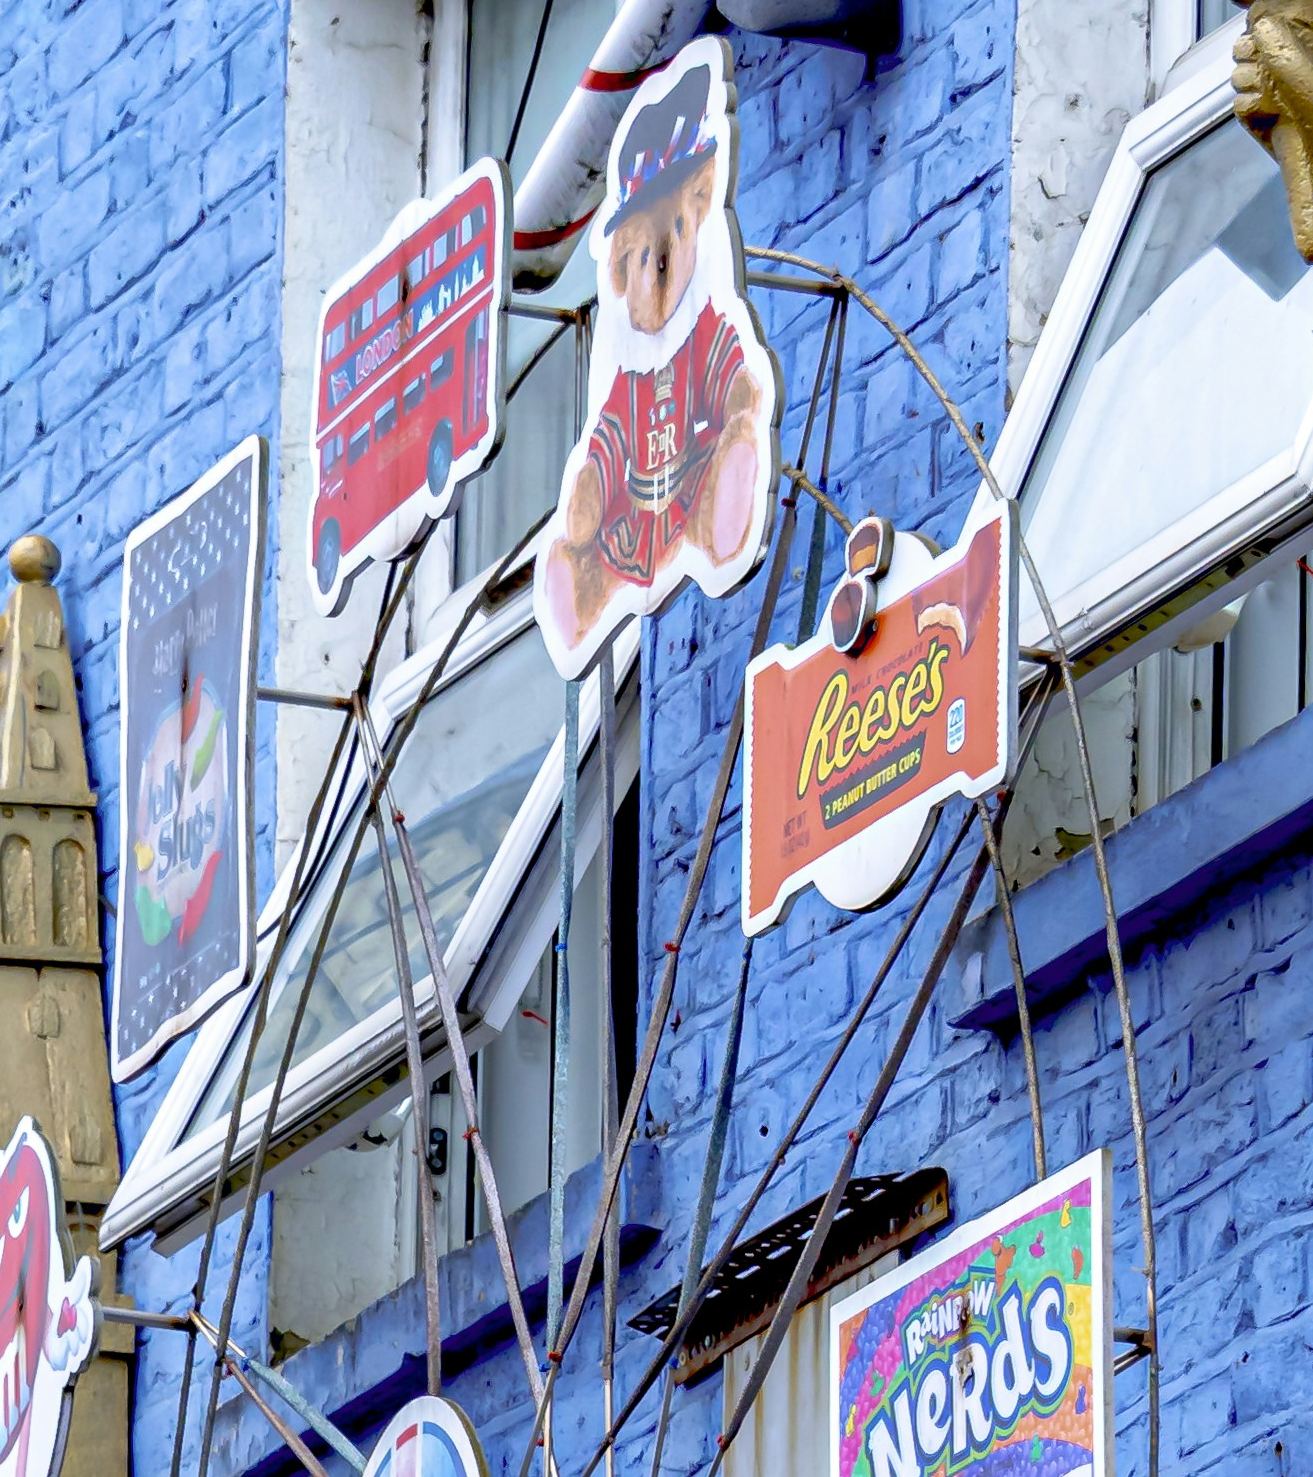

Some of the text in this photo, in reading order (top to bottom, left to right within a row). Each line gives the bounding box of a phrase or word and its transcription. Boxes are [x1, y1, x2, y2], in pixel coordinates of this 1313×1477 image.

[355, 308, 414, 385] LONDON
[797, 635, 950, 800] Reese's
[823, 747, 921, 821] 2 PEANUT BUTTER CUPS
